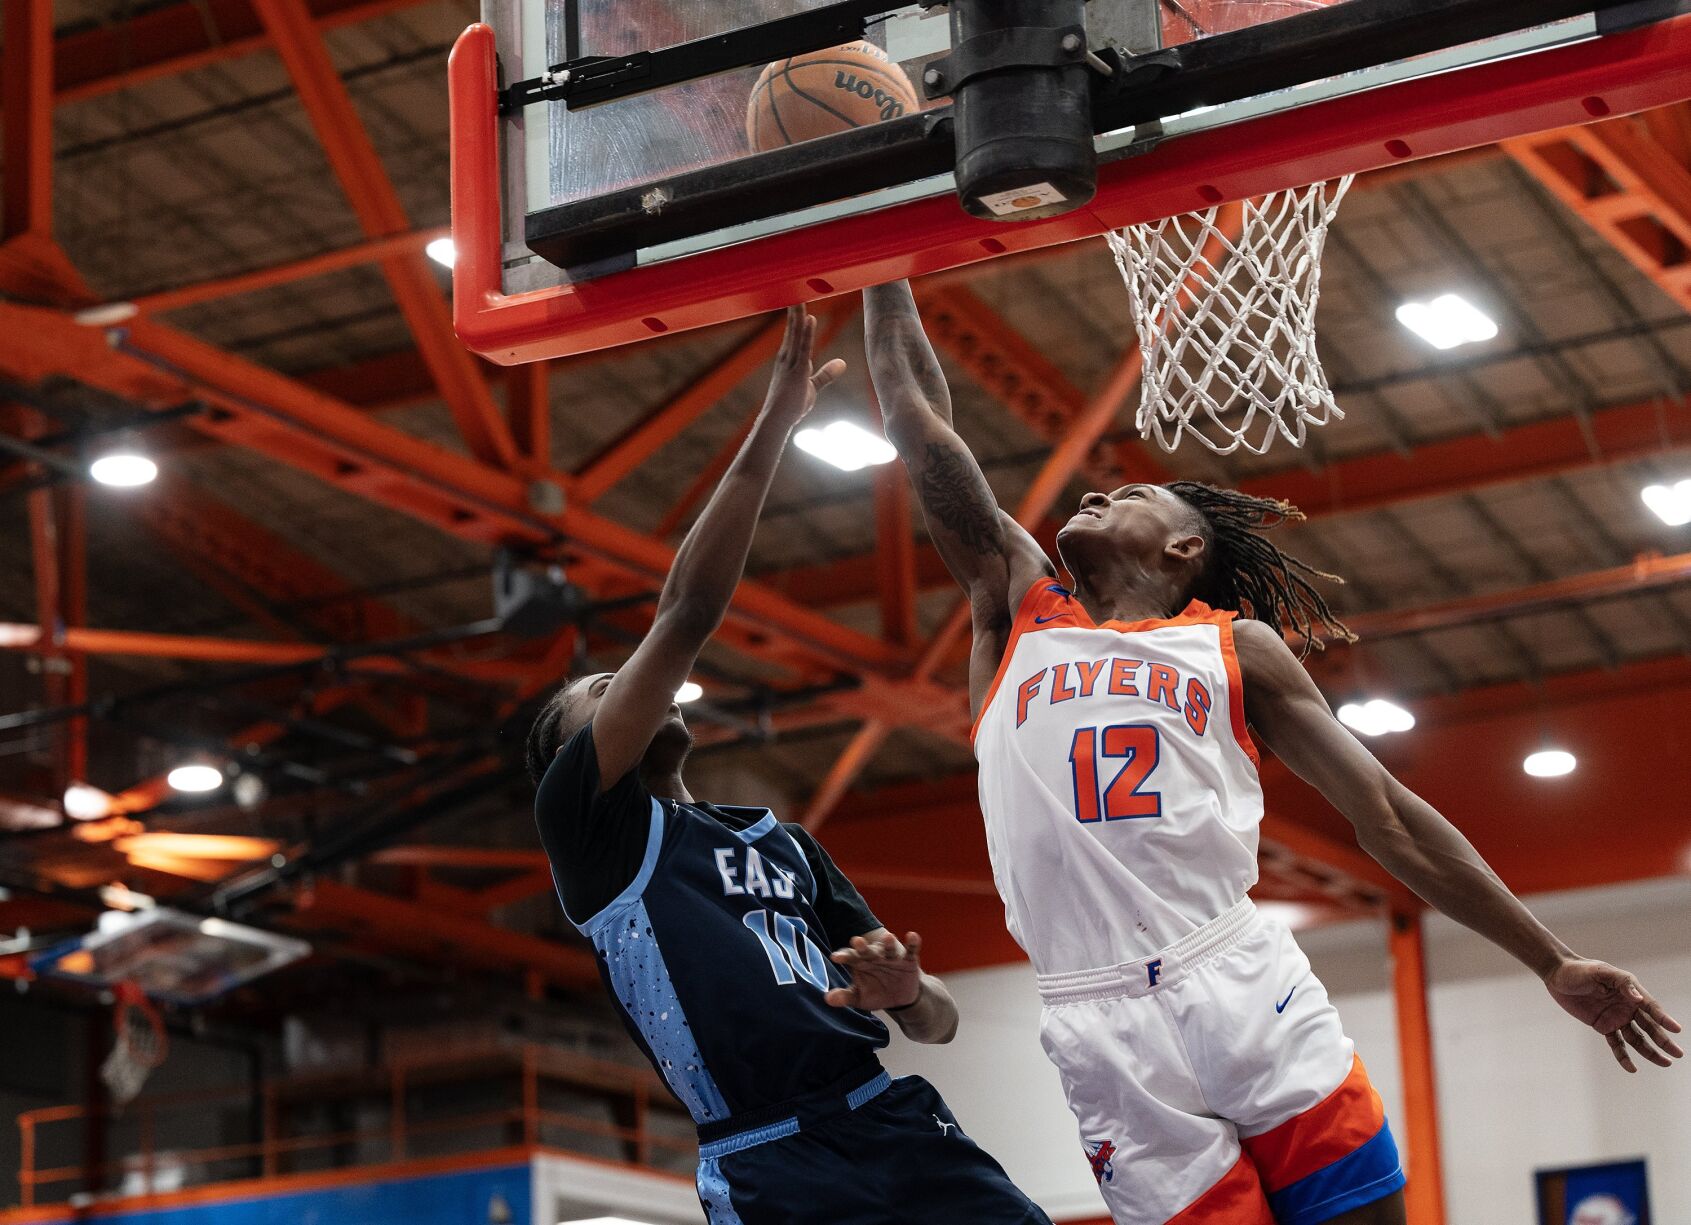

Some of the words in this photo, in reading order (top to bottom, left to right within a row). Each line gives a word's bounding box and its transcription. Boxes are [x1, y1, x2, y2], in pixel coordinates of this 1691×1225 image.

[1017, 658, 1211, 736] FLYERS
[1068, 724, 1161, 823] 12
[714, 847, 808, 904] EAS
[743, 909, 829, 992] 10
[1145, 957, 1163, 989] F
